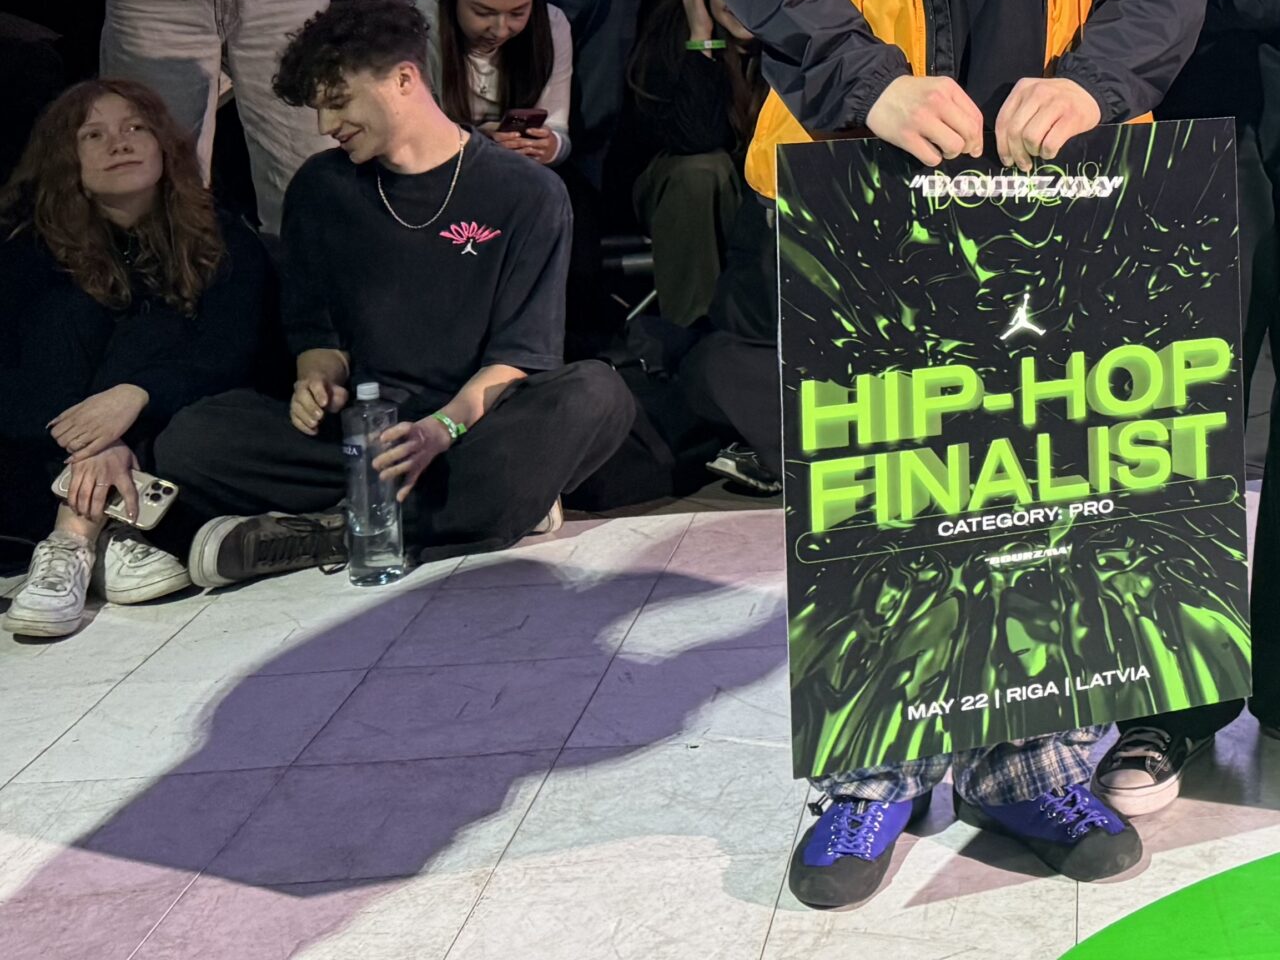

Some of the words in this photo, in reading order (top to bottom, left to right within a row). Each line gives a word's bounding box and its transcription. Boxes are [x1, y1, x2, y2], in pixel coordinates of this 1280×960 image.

[800, 337, 1233, 451] HIP-HOP
[810, 412, 1227, 533] FINALIST
[937, 506, 1063, 537] CATEGORY:
[1068, 499, 1115, 518] PRO
[907, 698, 954, 721] MAY
[960, 693, 989, 711] 22
[1006, 681, 1060, 703] RIGA
[1075, 665, 1151, 691] LATVIA
